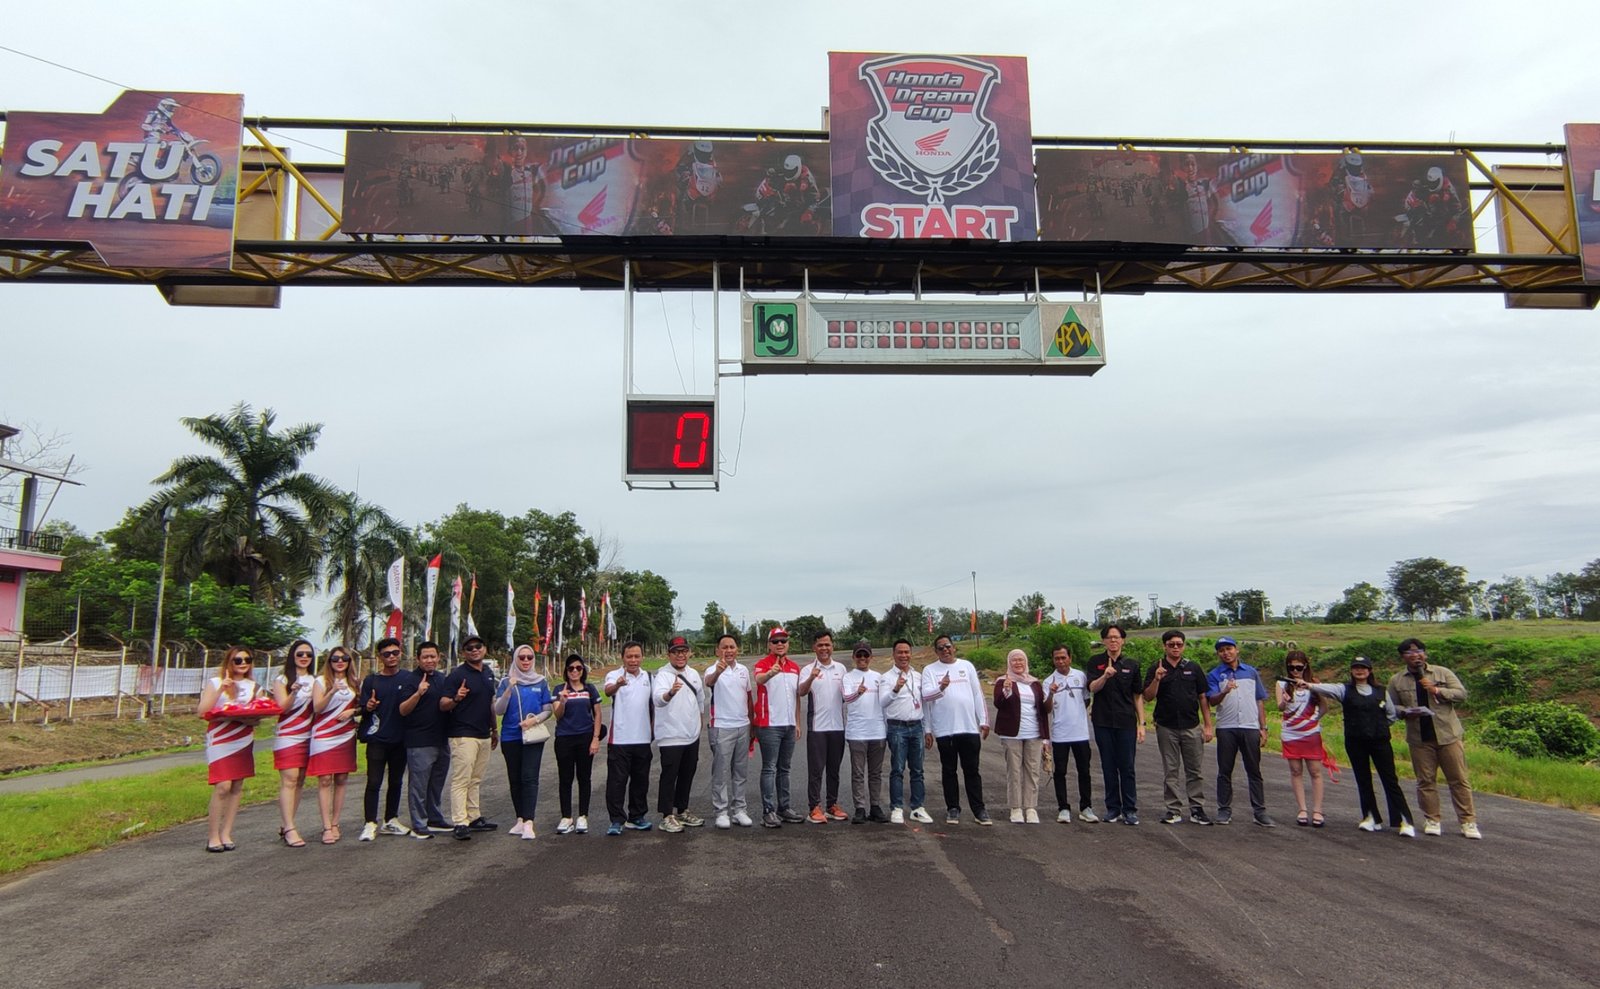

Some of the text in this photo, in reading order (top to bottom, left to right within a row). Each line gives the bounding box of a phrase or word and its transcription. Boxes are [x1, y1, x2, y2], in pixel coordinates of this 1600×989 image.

[885, 71, 964, 87] Honda
[894, 88, 976, 104] Dream
[905, 104, 953, 123] Cup
[20, 139, 186, 180] SATU
[562, 155, 606, 189] Cup
[67, 182, 216, 221] HATI
[1231, 171, 1268, 203] Cup
[861, 203, 1017, 241] START
[673, 412, 710, 468] 0
